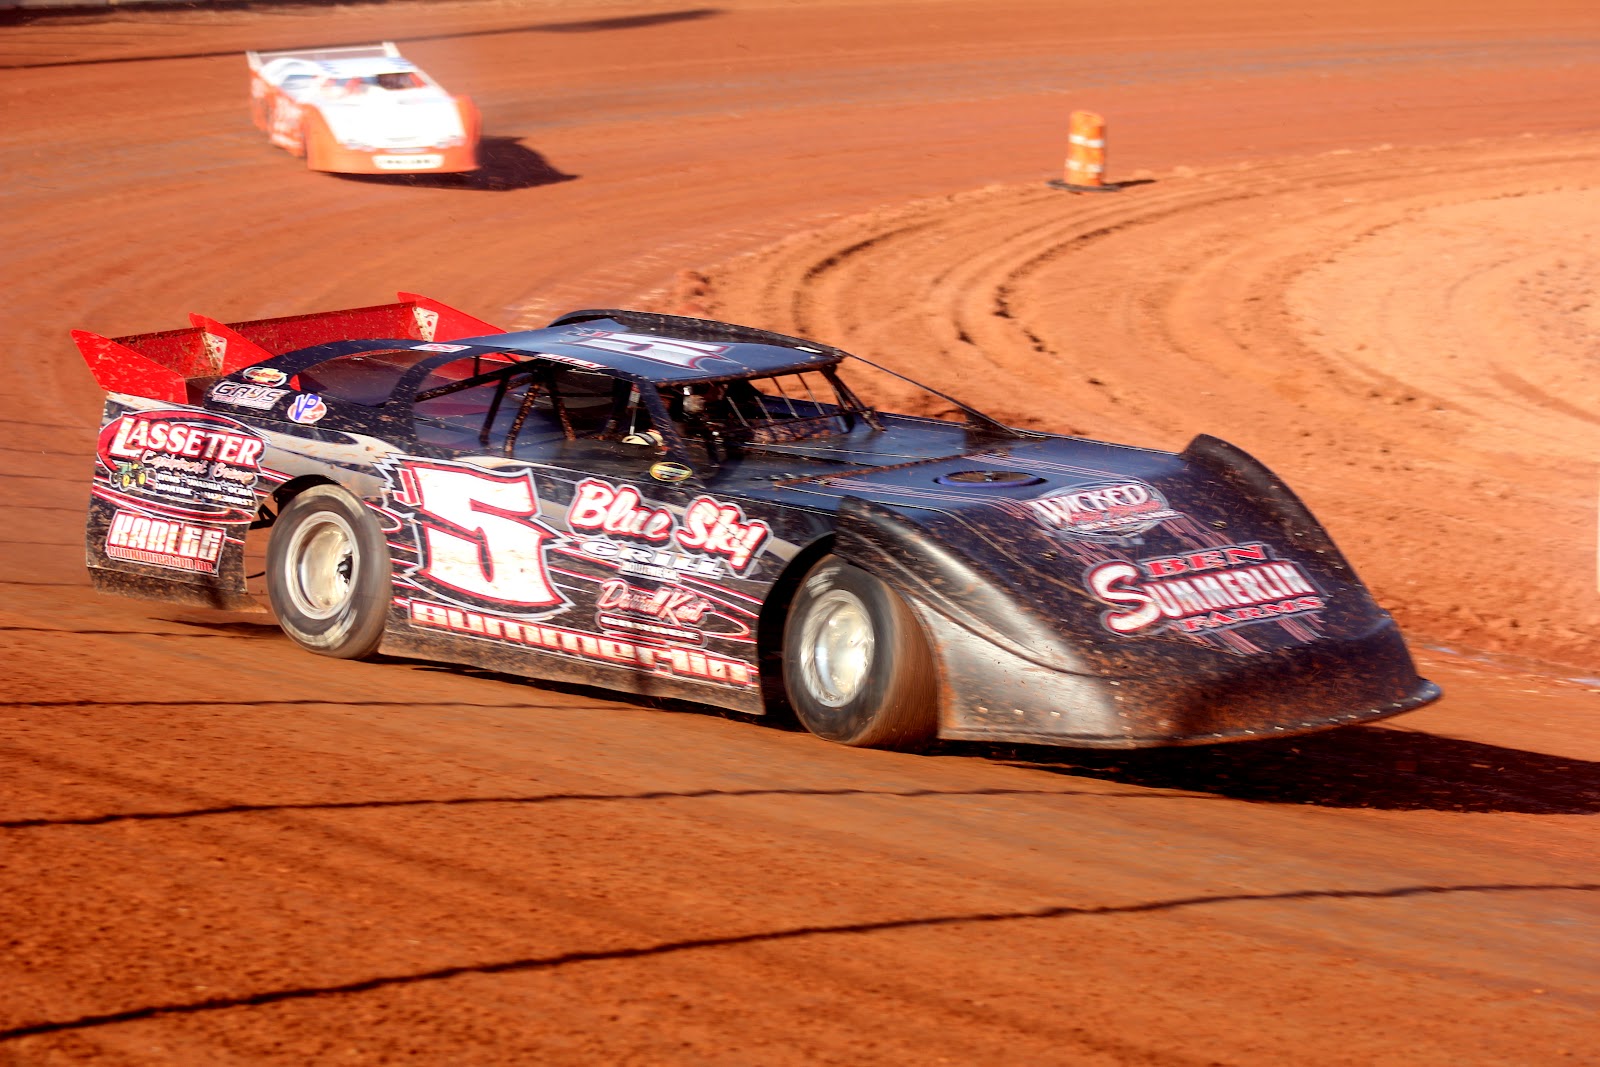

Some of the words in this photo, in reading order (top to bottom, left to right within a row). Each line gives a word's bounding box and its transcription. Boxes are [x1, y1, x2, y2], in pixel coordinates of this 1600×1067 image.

[294, 393, 321, 421] VP
[110, 416, 262, 467] LASSETER
[570, 481, 672, 541] Blue
[675, 498, 768, 569] Sky
[1029, 485, 1148, 527] WICKED
[109, 514, 223, 562] KARLEE
[407, 463, 563, 606] 5
[581, 540, 724, 578] GRILL
[1143, 544, 1268, 578] BEN
[1089, 561, 1317, 632] SUMMERLIN
[1179, 597, 1326, 632] FARMS
